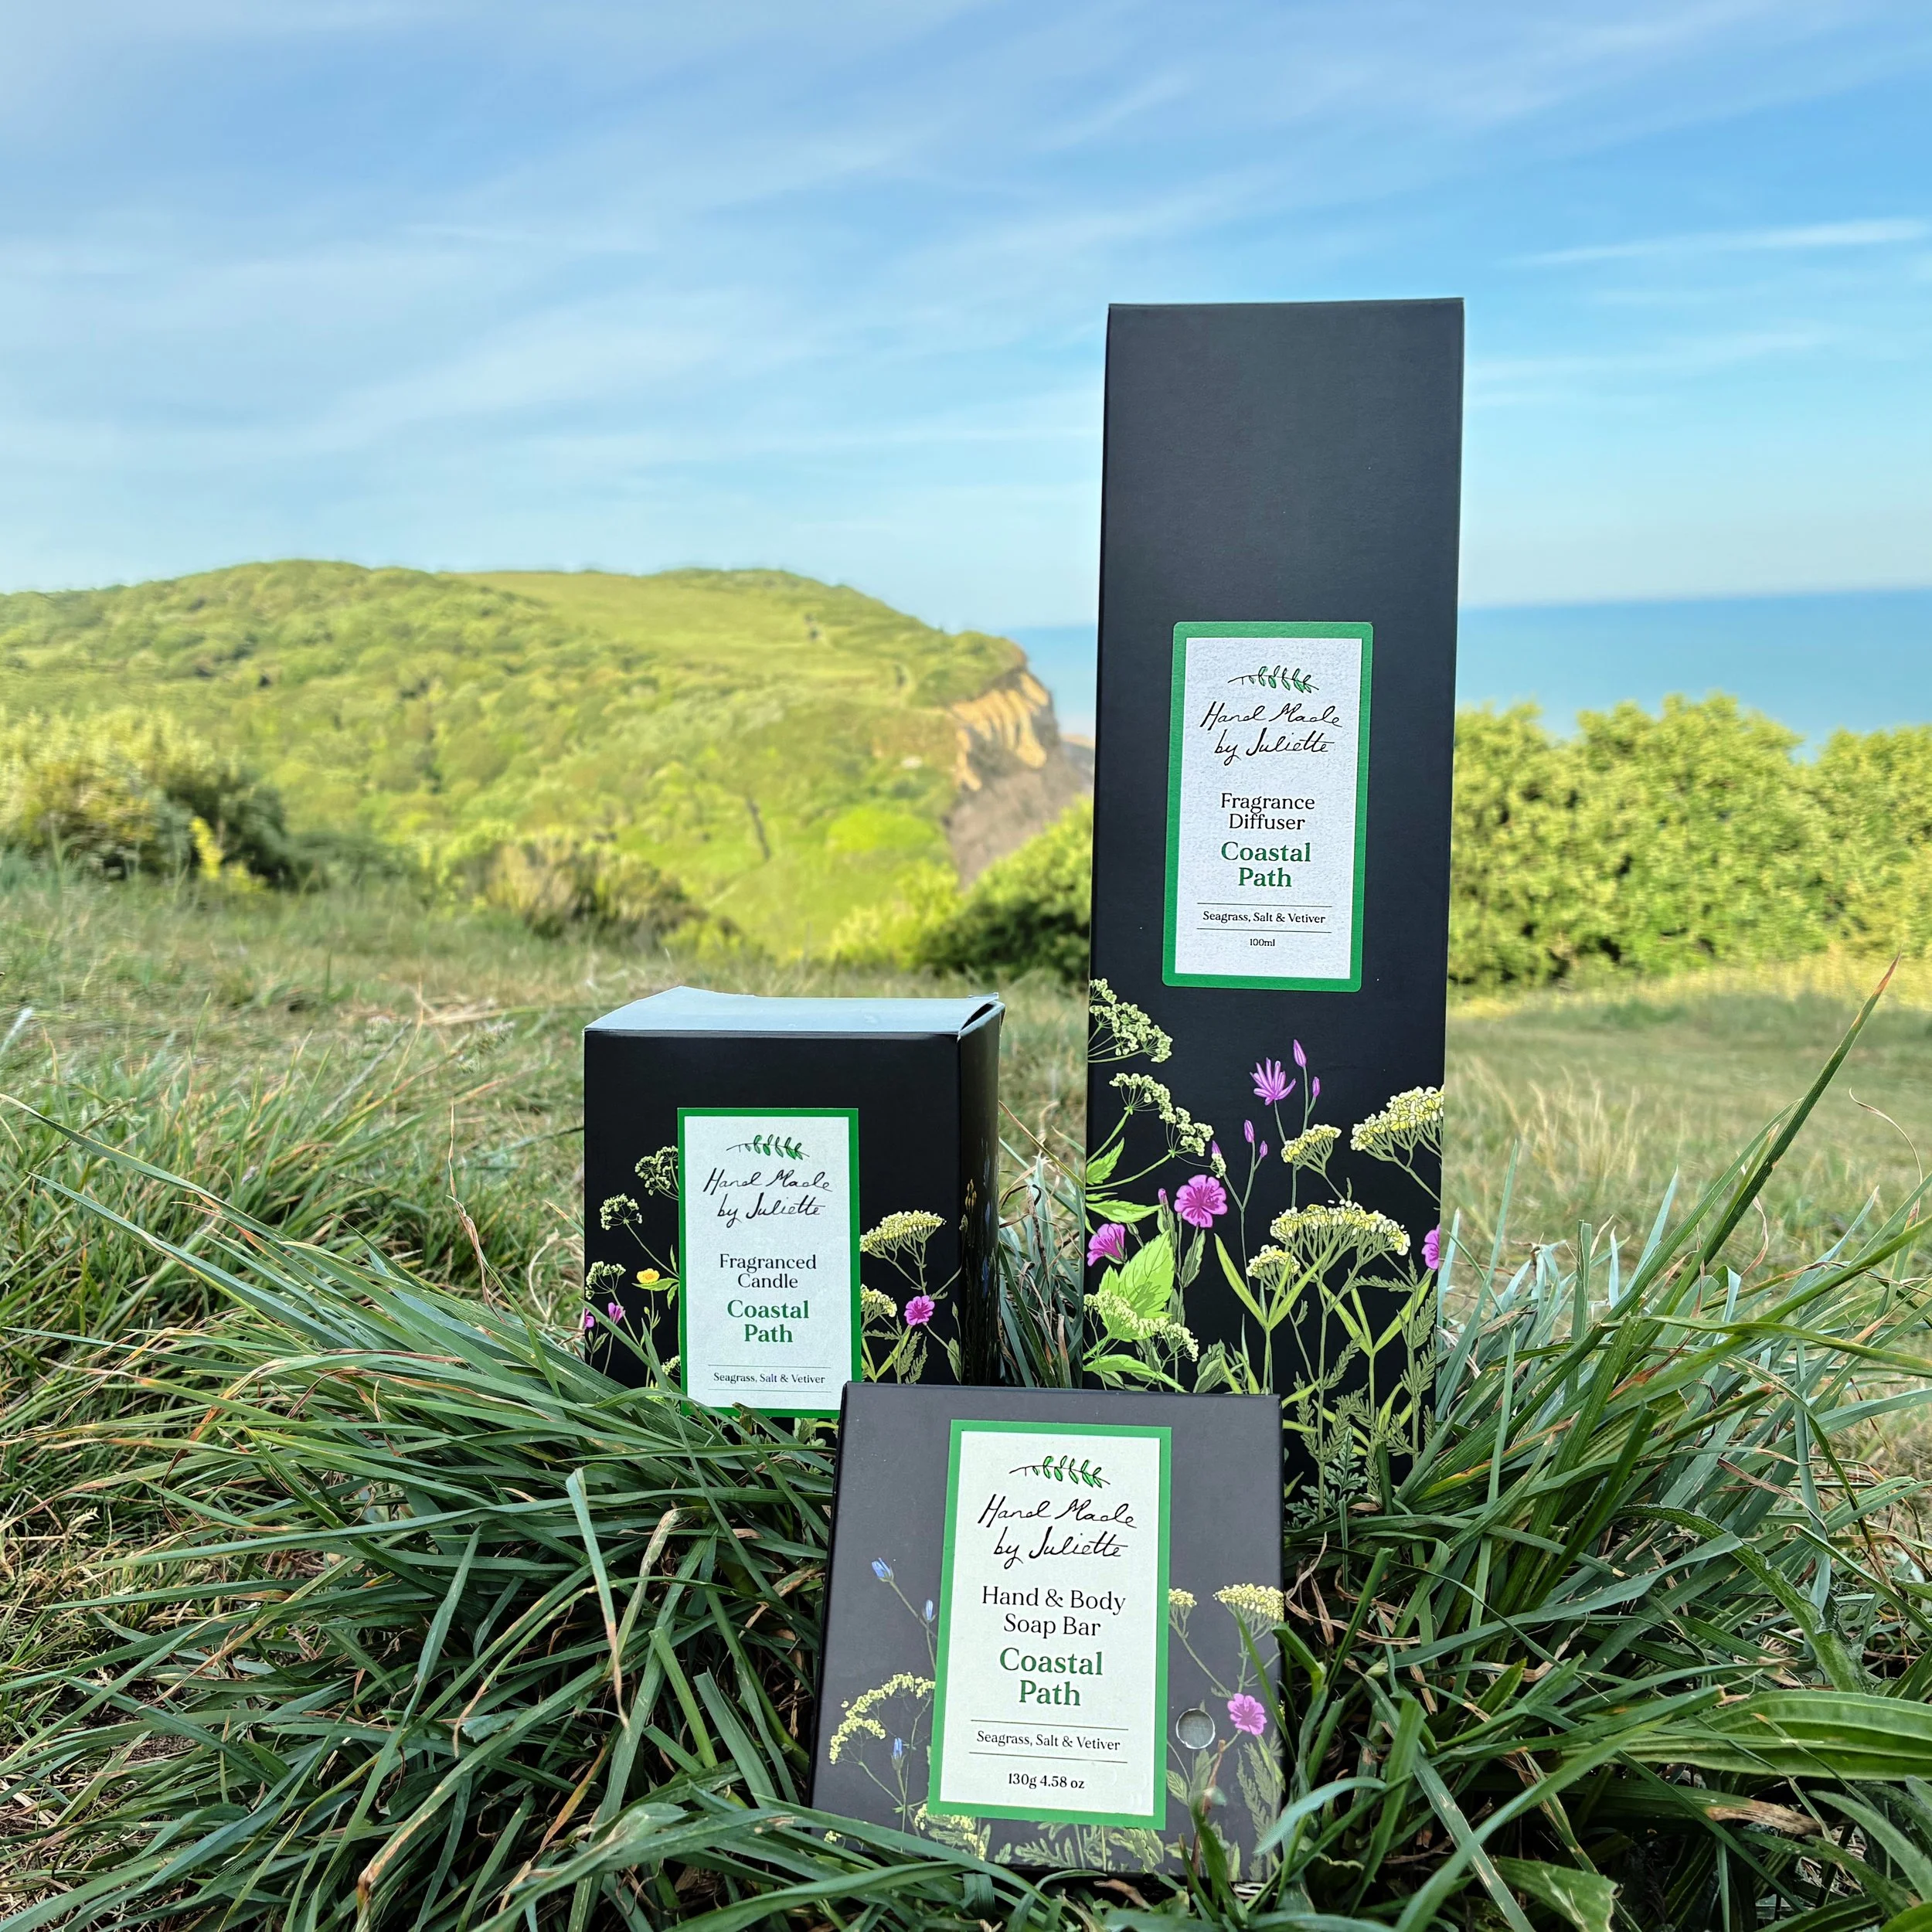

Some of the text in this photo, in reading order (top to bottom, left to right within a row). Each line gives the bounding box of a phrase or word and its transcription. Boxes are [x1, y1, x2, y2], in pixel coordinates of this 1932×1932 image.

[1199, 700, 1343, 731] Hand Made
[1213, 728, 1335, 767] by Juliette
[1220, 791, 1315, 815] Fragrance
[1229, 813, 1306, 831] Diffuser
[1220, 841, 1311, 863] Coastal
[1238, 867, 1292, 888] Path
[1202, 910, 1326, 924] Seagrass, Salt & Vetiver
[1250, 938, 1276, 947] 100ml
[703, 1168, 833, 1196] Hand Made
[717, 1192, 826, 1228] by Juliette
[719, 1253, 817, 1273] Fragranced
[738, 1273, 798, 1289] Candle
[727, 1299, 809, 1319] Coastal
[744, 1324, 794, 1343] Path
[713, 1372, 825, 1385] Seagrass, Salt & Vetiver
[978, 1494, 1138, 1529] Hand Made
[993, 1526, 1128, 1570] by Juliette
[981, 1586, 1126, 1614] Hand & Body
[1003, 1614, 1101, 1638] Soap Bar
[999, 1647, 1104, 1676] Coastal
[1018, 1679, 1081, 1706] Path
[976, 1730, 1121, 1751] Seagrass, Salt & Vetiver
[1008, 1773, 1085, 1790] 130g 4.58 oz
